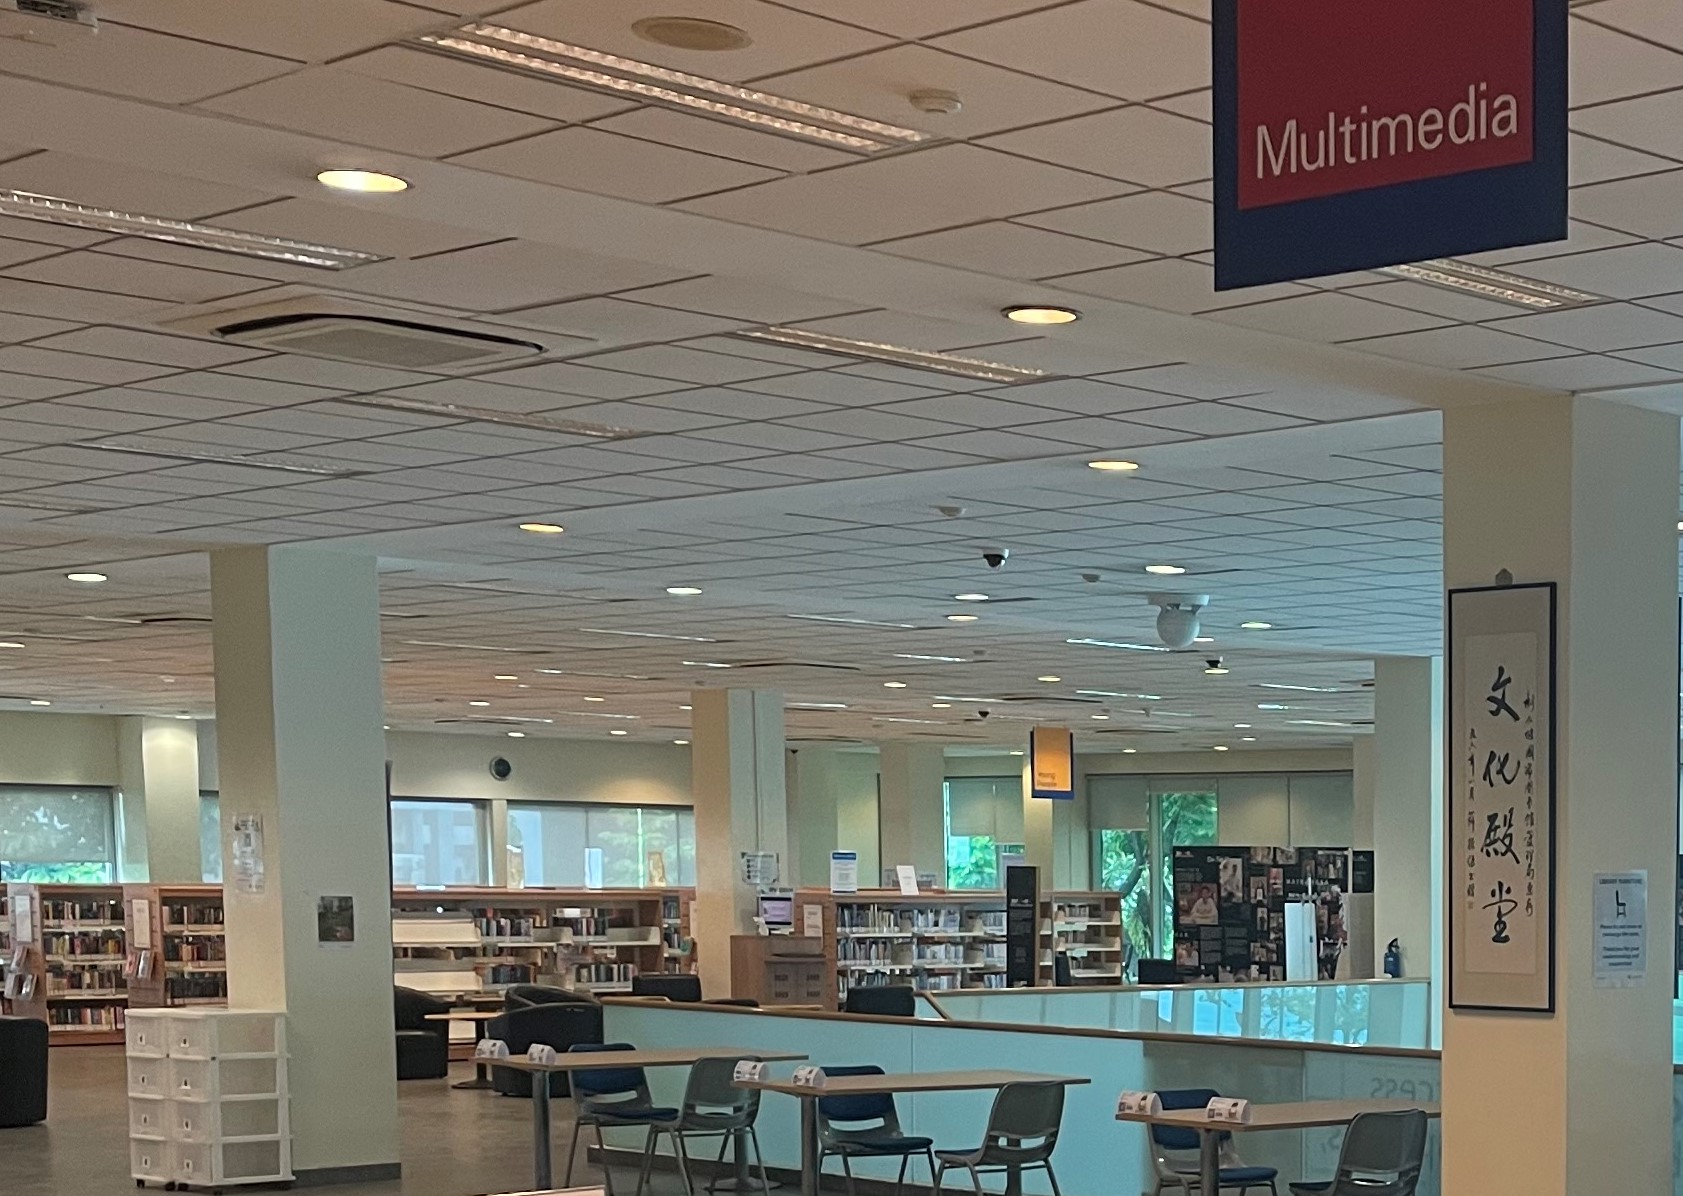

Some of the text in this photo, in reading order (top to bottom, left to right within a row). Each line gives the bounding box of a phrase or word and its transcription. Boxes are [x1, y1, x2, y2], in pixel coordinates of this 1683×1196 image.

[1256, 82, 1518, 179] Multimedia
[1480, 665, 1520, 943] 文化殿堂
